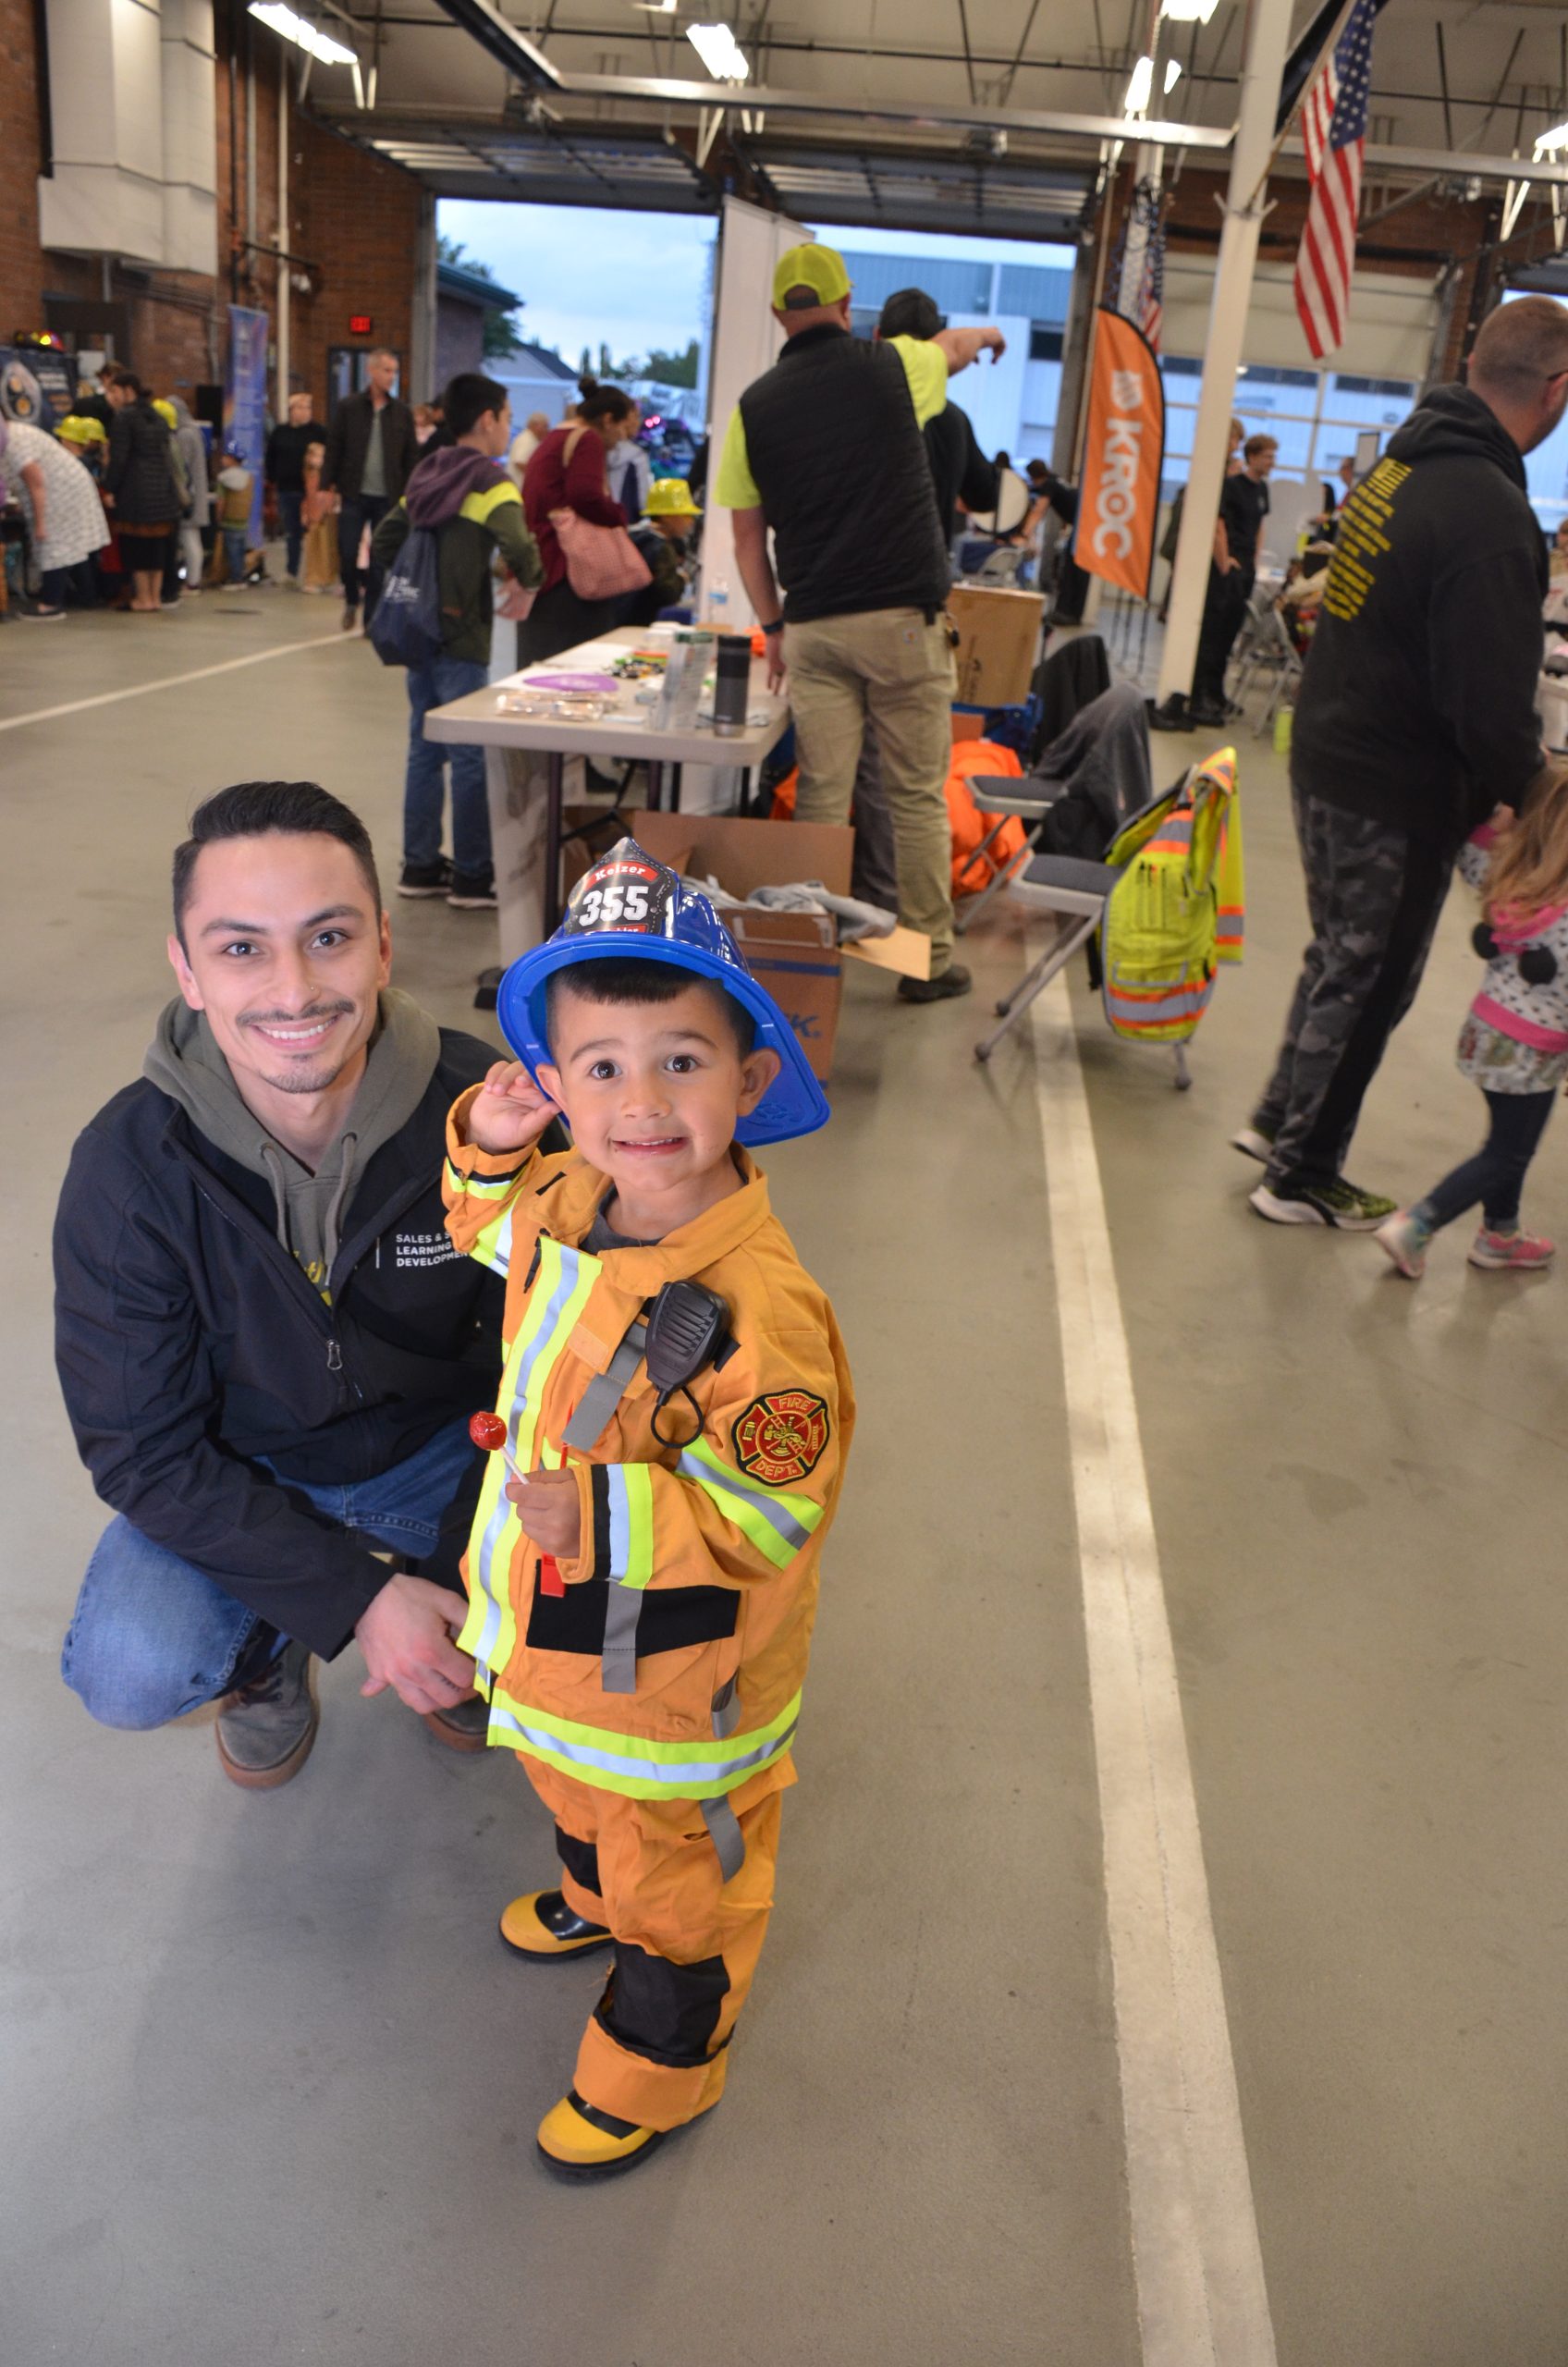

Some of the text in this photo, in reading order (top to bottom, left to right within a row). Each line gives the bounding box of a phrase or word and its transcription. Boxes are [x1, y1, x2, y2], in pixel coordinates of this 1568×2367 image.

[1093, 418, 1143, 560] KROC
[594, 864, 646, 881] Keizer
[579, 886, 648, 926] 355
[396, 1233, 432, 1244] SALES
[435, 1233, 443, 1242] &
[396, 1241, 452, 1255] LEARNING
[778, 1397, 811, 1411] FIRE
